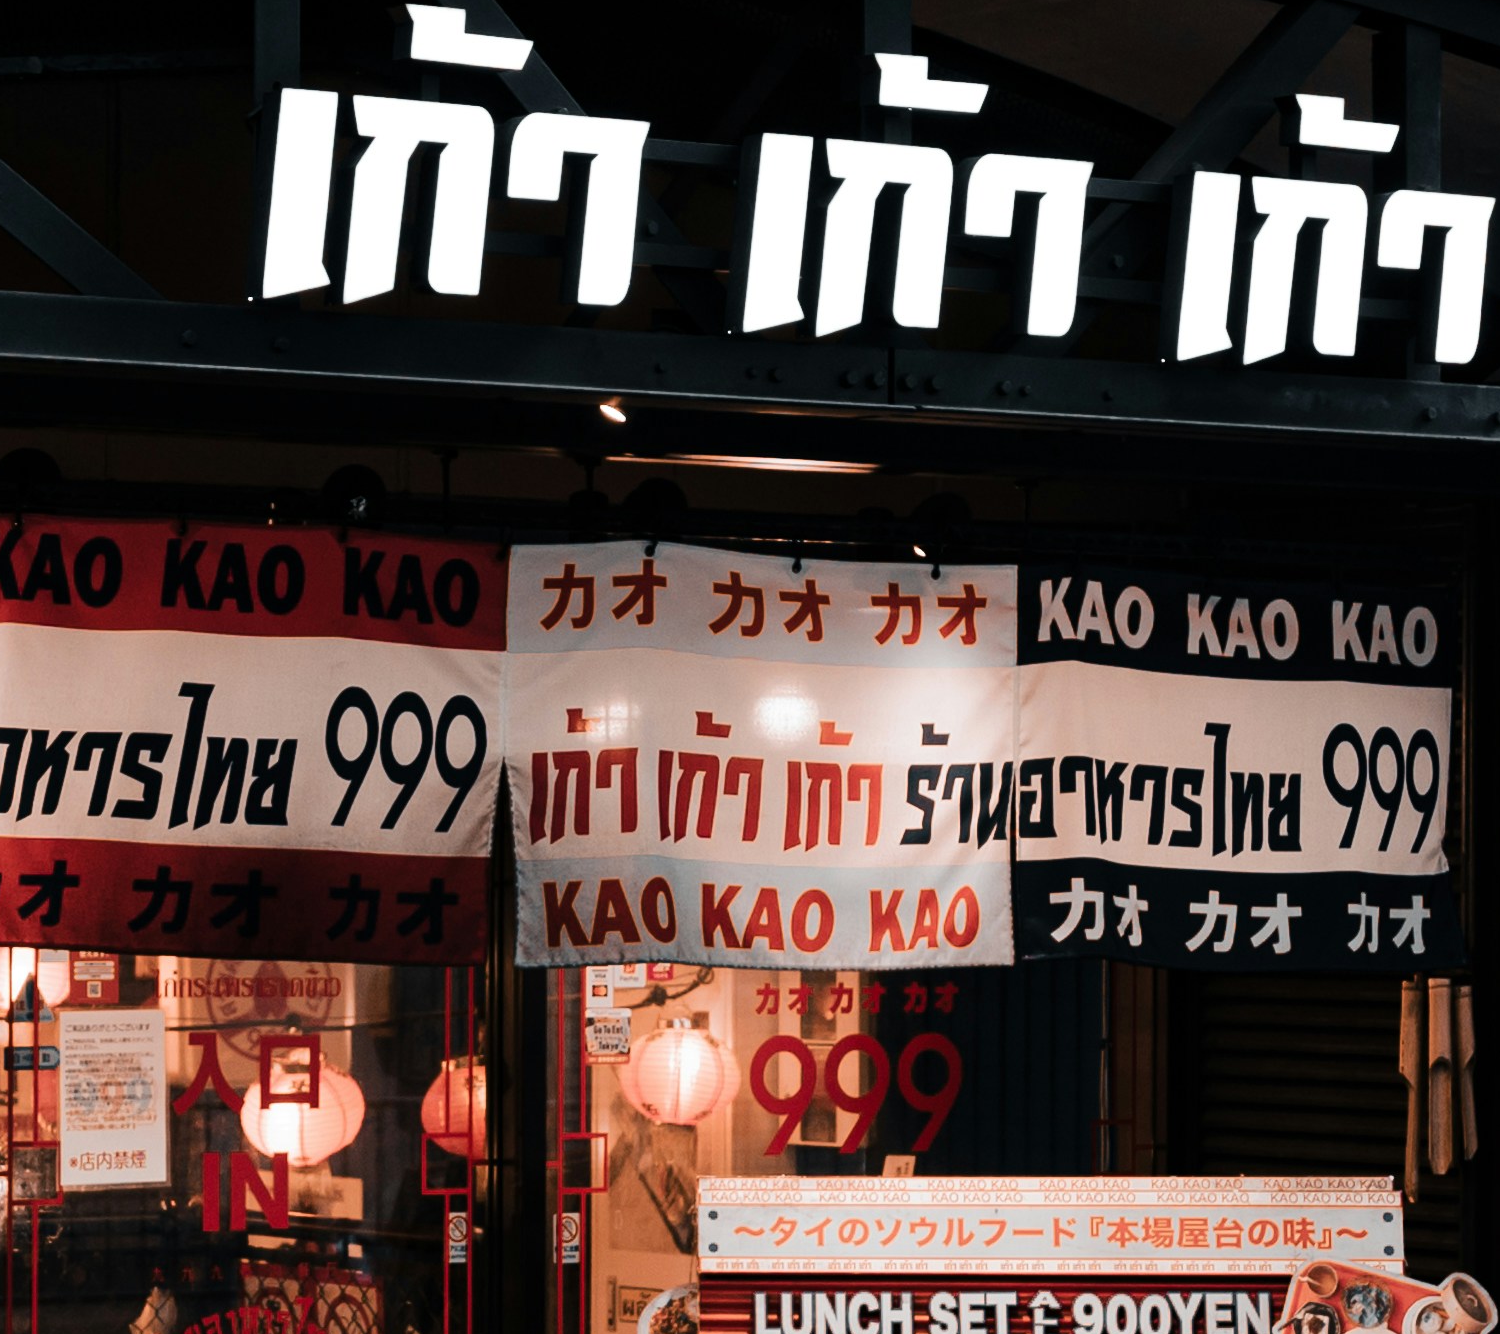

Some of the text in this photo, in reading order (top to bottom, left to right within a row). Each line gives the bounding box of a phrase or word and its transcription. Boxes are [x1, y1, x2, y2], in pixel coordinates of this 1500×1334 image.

[261, 3, 1496, 366] เก้า เก้า เก้า
[160, 538, 306, 615] KAO
[342, 547, 480, 627] KAO
[540, 558, 988, 645] カオ カオ カオ
[1037, 576, 1438, 667] KAO KAO KAO
[325, 686, 488, 833] 999
[529, 707, 1440, 858] เก้า เก้า เก้า ร้านอาหารไทย 999
[127, 866, 277, 938] カオ
[326, 873, 459, 945] カオ
[543, 875, 980, 953] KAO KAO KAO
[1049, 877, 1431, 955] カオ カオ カオ
[755, 981, 959, 1015] カオ カオ カオ
[172, 1032, 320, 1116] 入口
[750, 1032, 963, 1156] 999
[202, 1152, 289, 1232] IN
